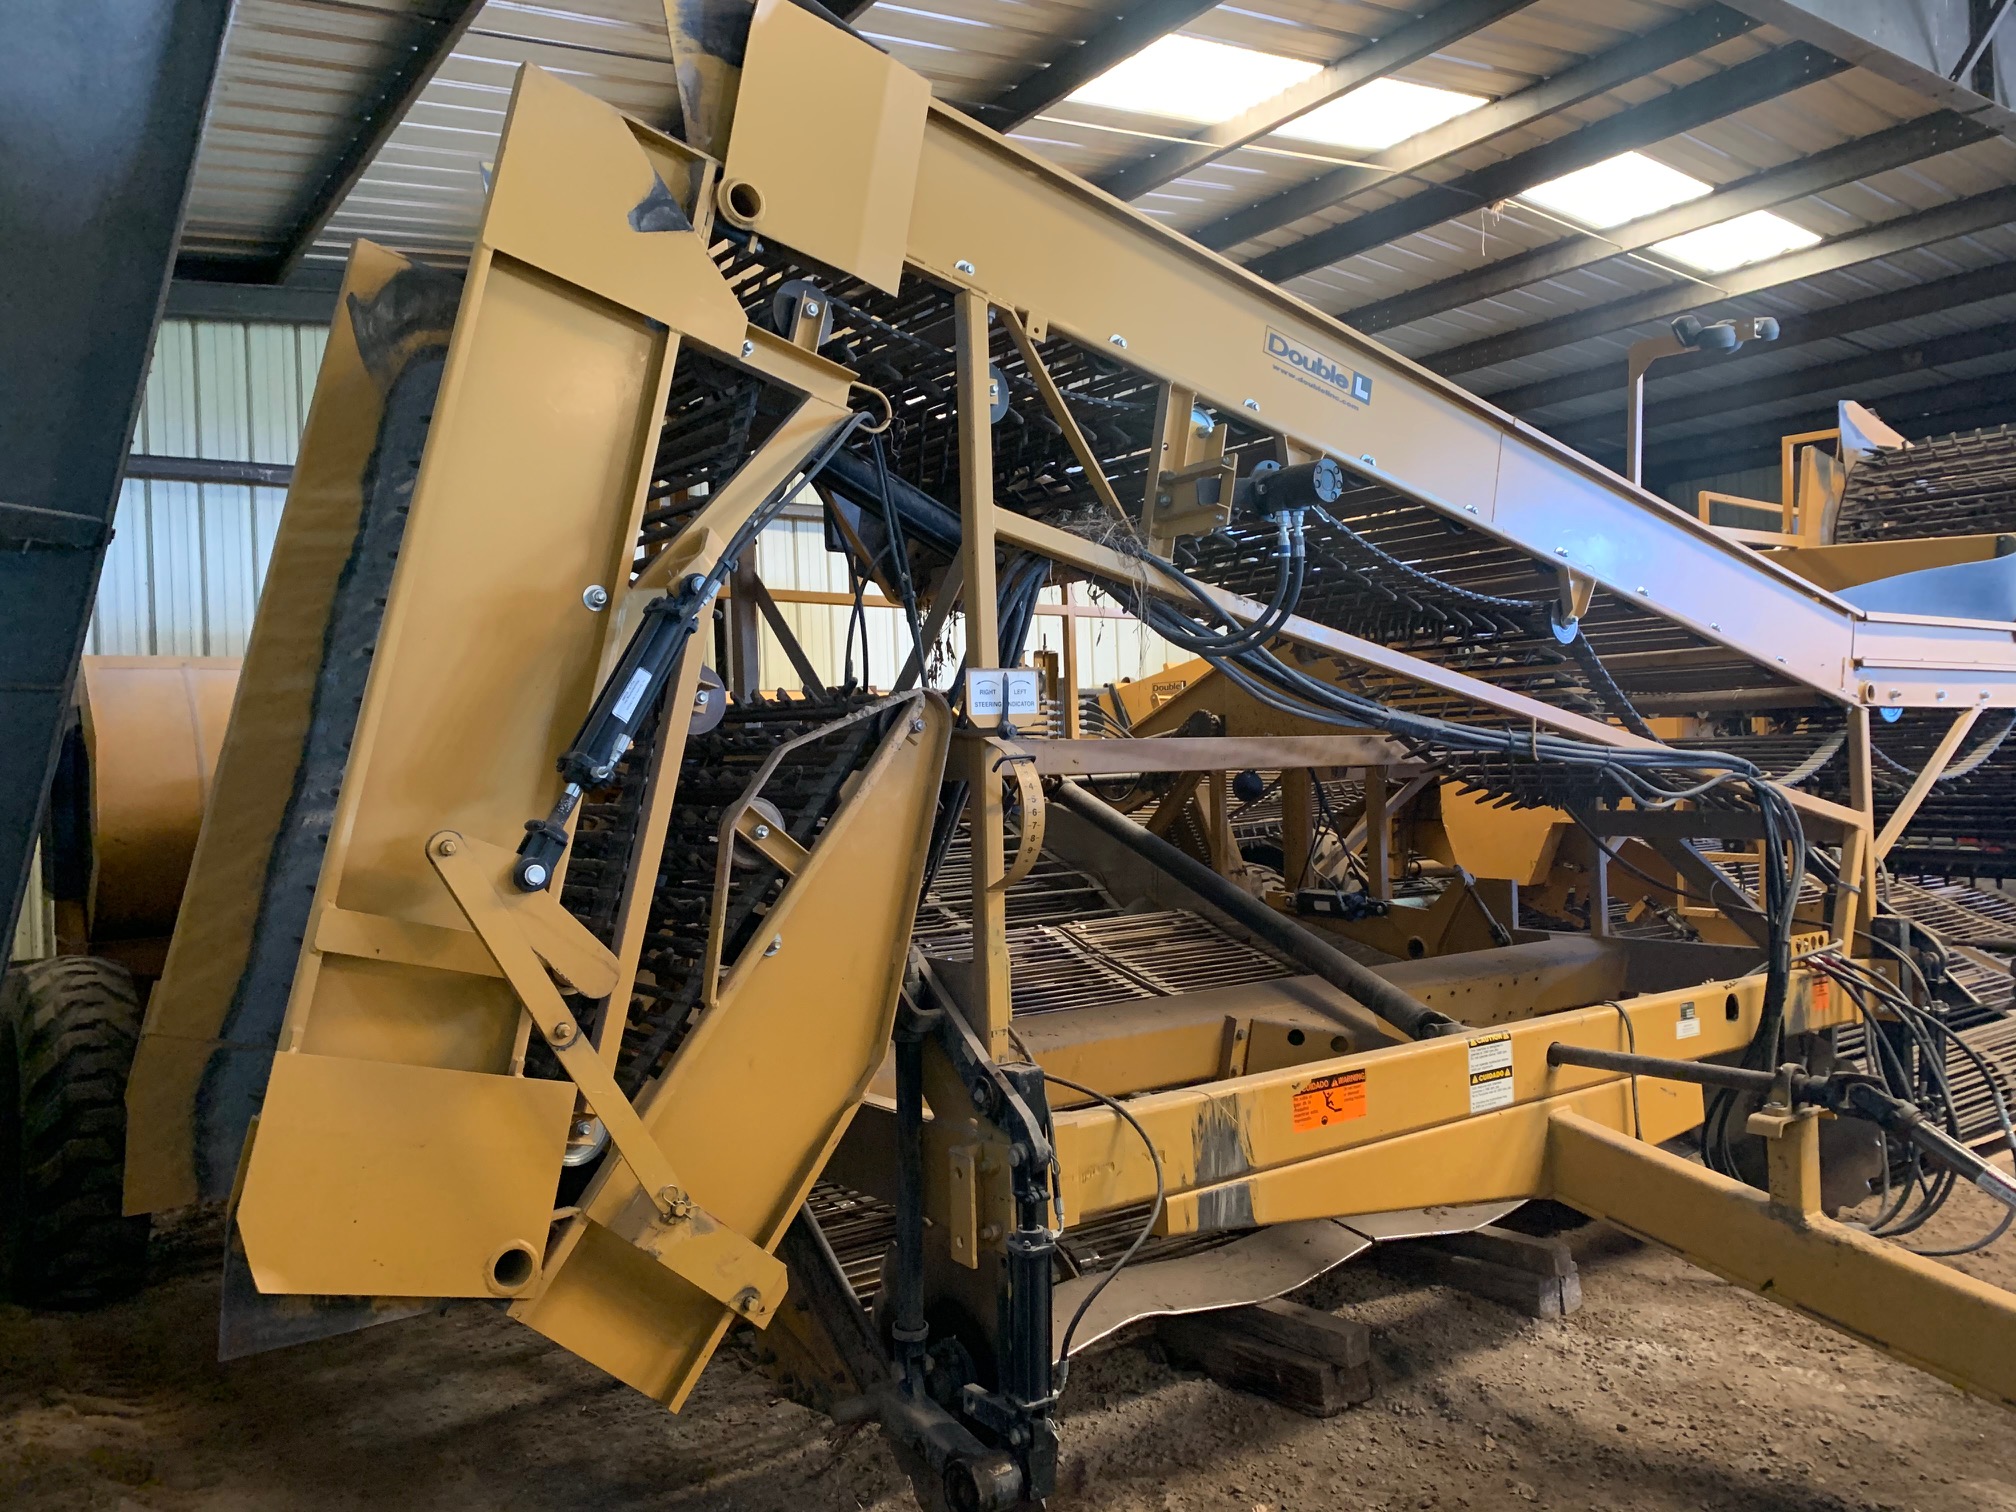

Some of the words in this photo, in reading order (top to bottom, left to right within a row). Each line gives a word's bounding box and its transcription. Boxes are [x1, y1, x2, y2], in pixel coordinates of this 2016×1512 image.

[1268, 332, 1349, 389] Double
[1152, 683, 1180, 691] Double
[1032, 808, 1038, 816] 6
[1032, 821, 1038, 829] 7
[1030, 834, 1036, 842] 8
[1027, 846, 1033, 854] 9
[1478, 1033, 1503, 1044] CAUTION
[1337, 1072, 1366, 1085] WARNING
[1478, 1070, 1504, 1082] CUIDADO
